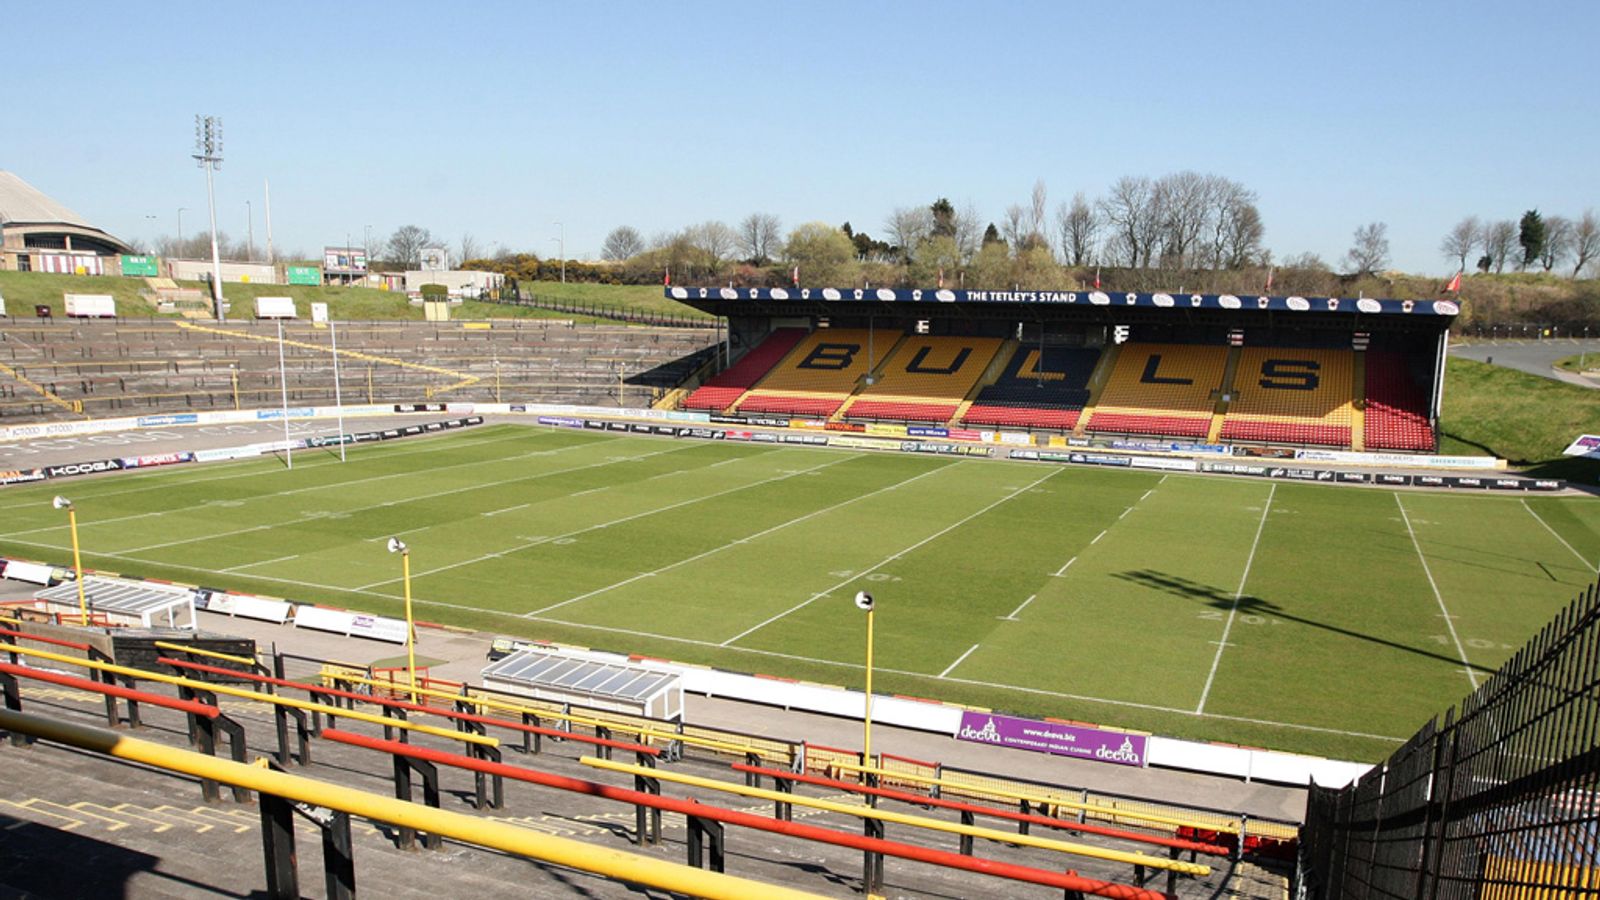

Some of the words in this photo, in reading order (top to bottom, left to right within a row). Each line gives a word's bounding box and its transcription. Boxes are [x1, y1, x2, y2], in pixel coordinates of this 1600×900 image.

[967, 291, 987, 301] THE
[989, 291, 1036, 302] TETLEY'S
[1039, 292, 1076, 302] STAND
[141, 453, 178, 465] SPORTS
[51, 460, 119, 476] KOOGA
[1196, 610, 1266, 625] 20
[960, 724, 1001, 742] deeva
[1048, 742, 1068, 751] INDIAN
[1096, 744, 1139, 763] deeva
